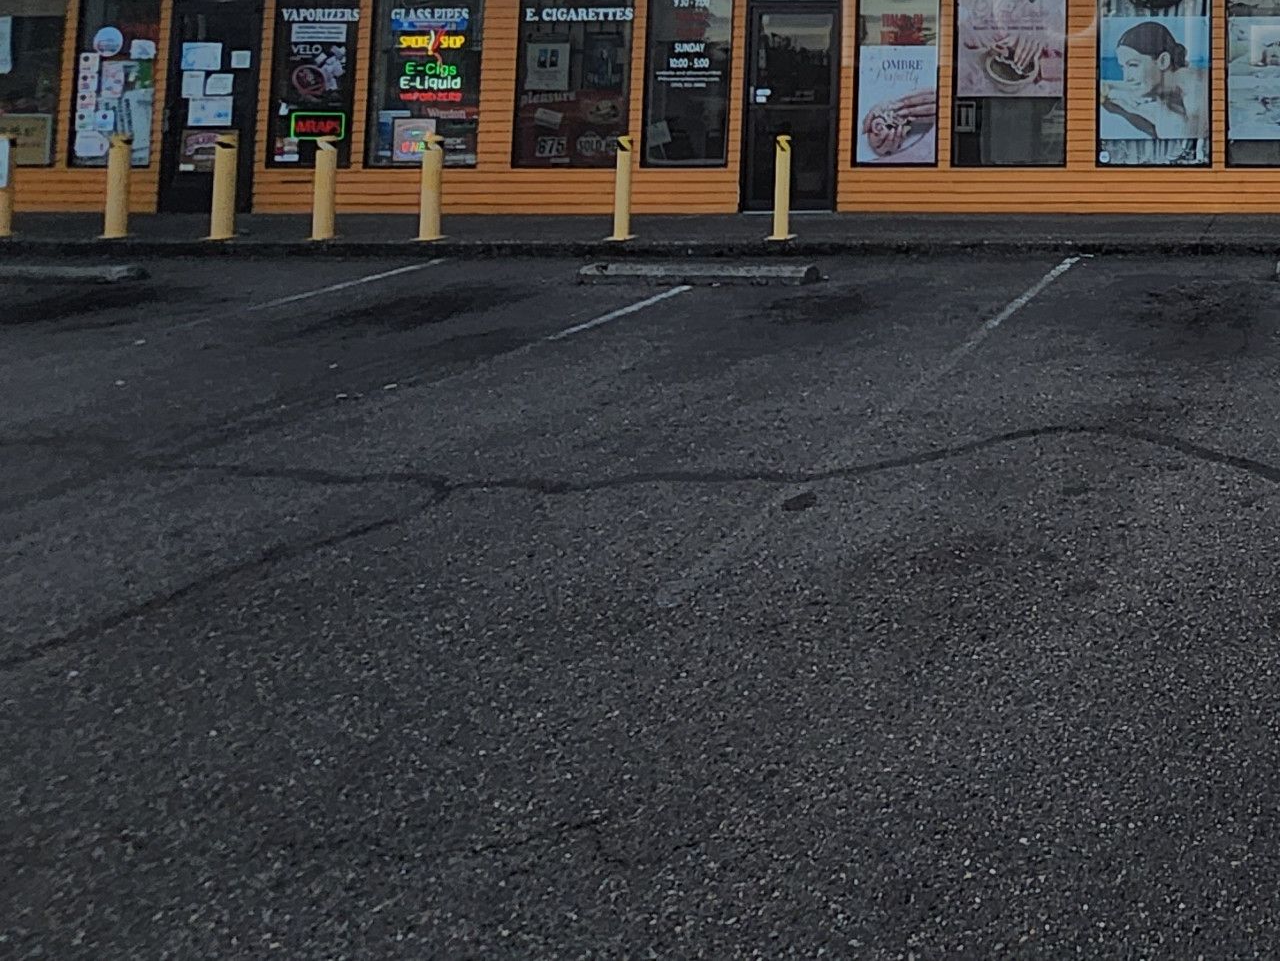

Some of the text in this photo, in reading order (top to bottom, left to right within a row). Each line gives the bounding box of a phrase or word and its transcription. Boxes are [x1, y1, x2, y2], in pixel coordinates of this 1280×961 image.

[282, 8, 360, 22] VAPORIZERS
[391, 8, 432, 21] GLASS
[525, 7, 634, 22] E. CIGARETTES
[292, 44, 322, 55] VELO
[674, 42, 706, 53] SUNDAY
[405, 62, 457, 77] E-Cigs
[882, 59, 924, 71] OMBRE
[400, 75, 461, 91] E-Liquid
